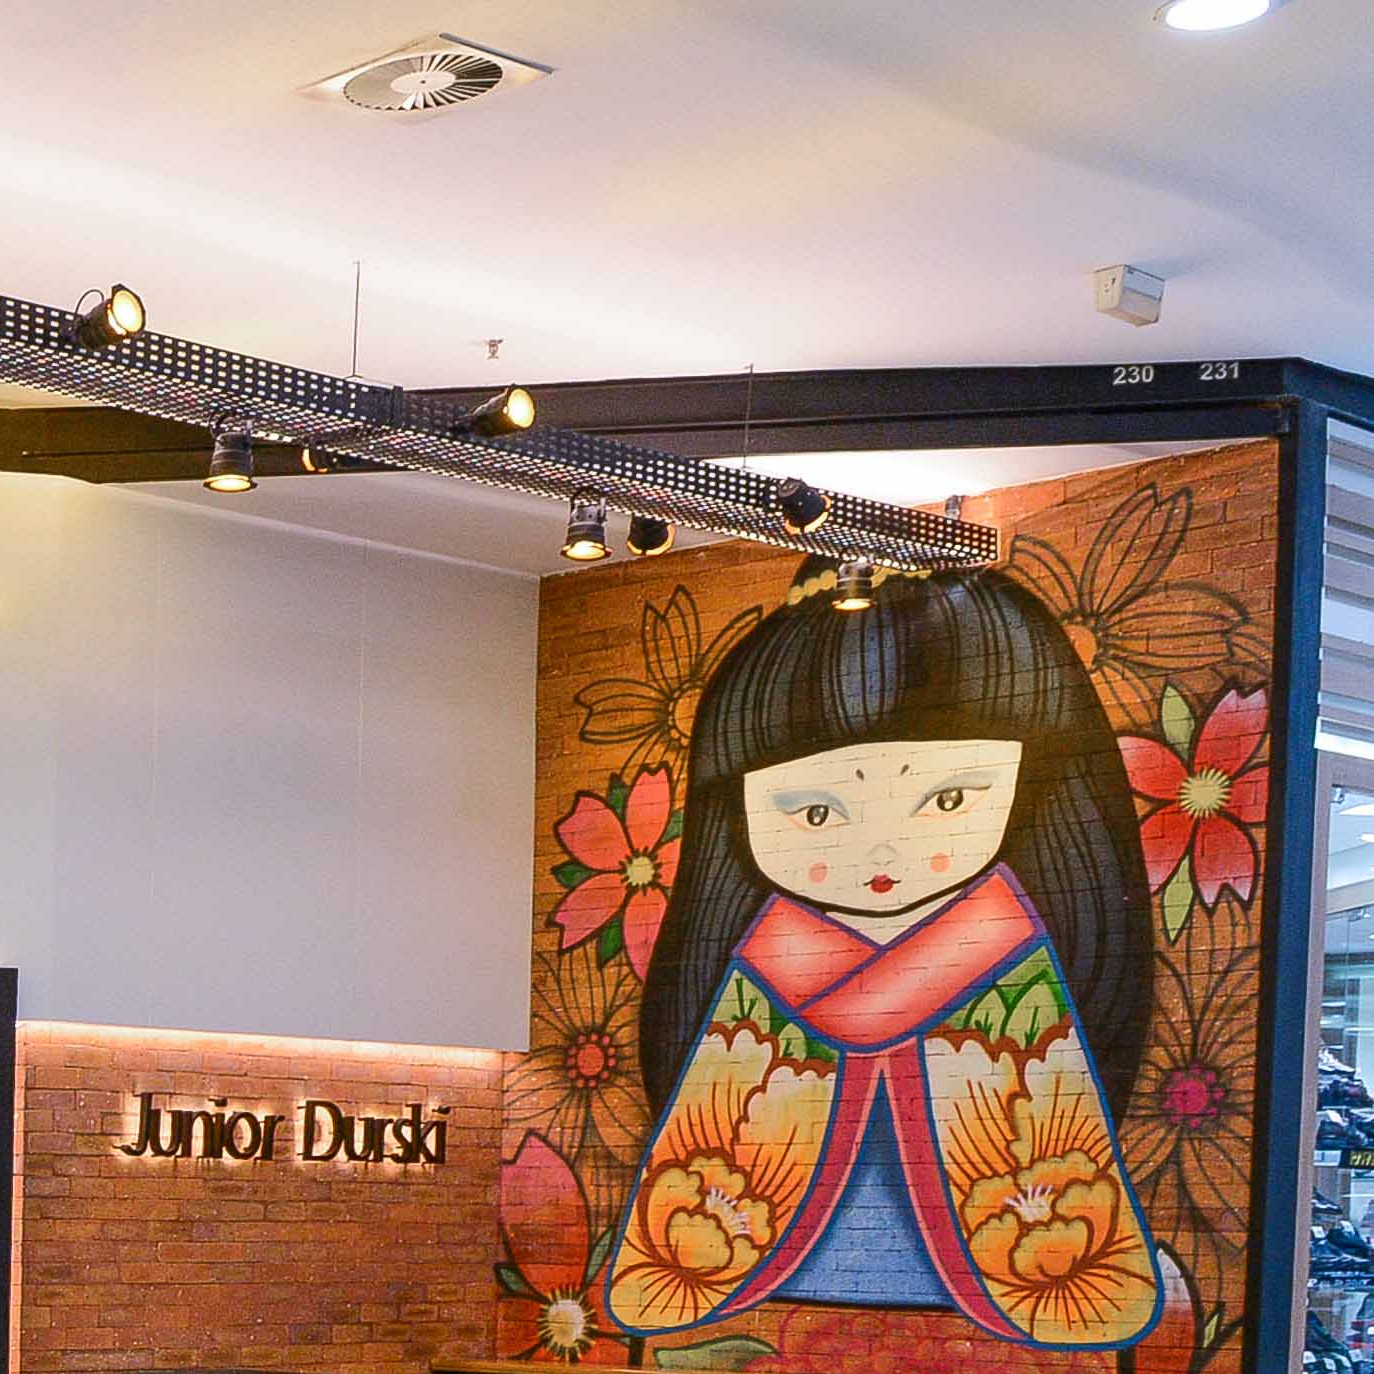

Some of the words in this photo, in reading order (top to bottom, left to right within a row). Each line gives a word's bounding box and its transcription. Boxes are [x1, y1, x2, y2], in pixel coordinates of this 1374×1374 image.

[1113, 365, 1154, 385] 230
[1200, 362, 1239, 380] 231
[113, 1091, 285, 1161] Junior
[297, 1099, 452, 1164] Durski
